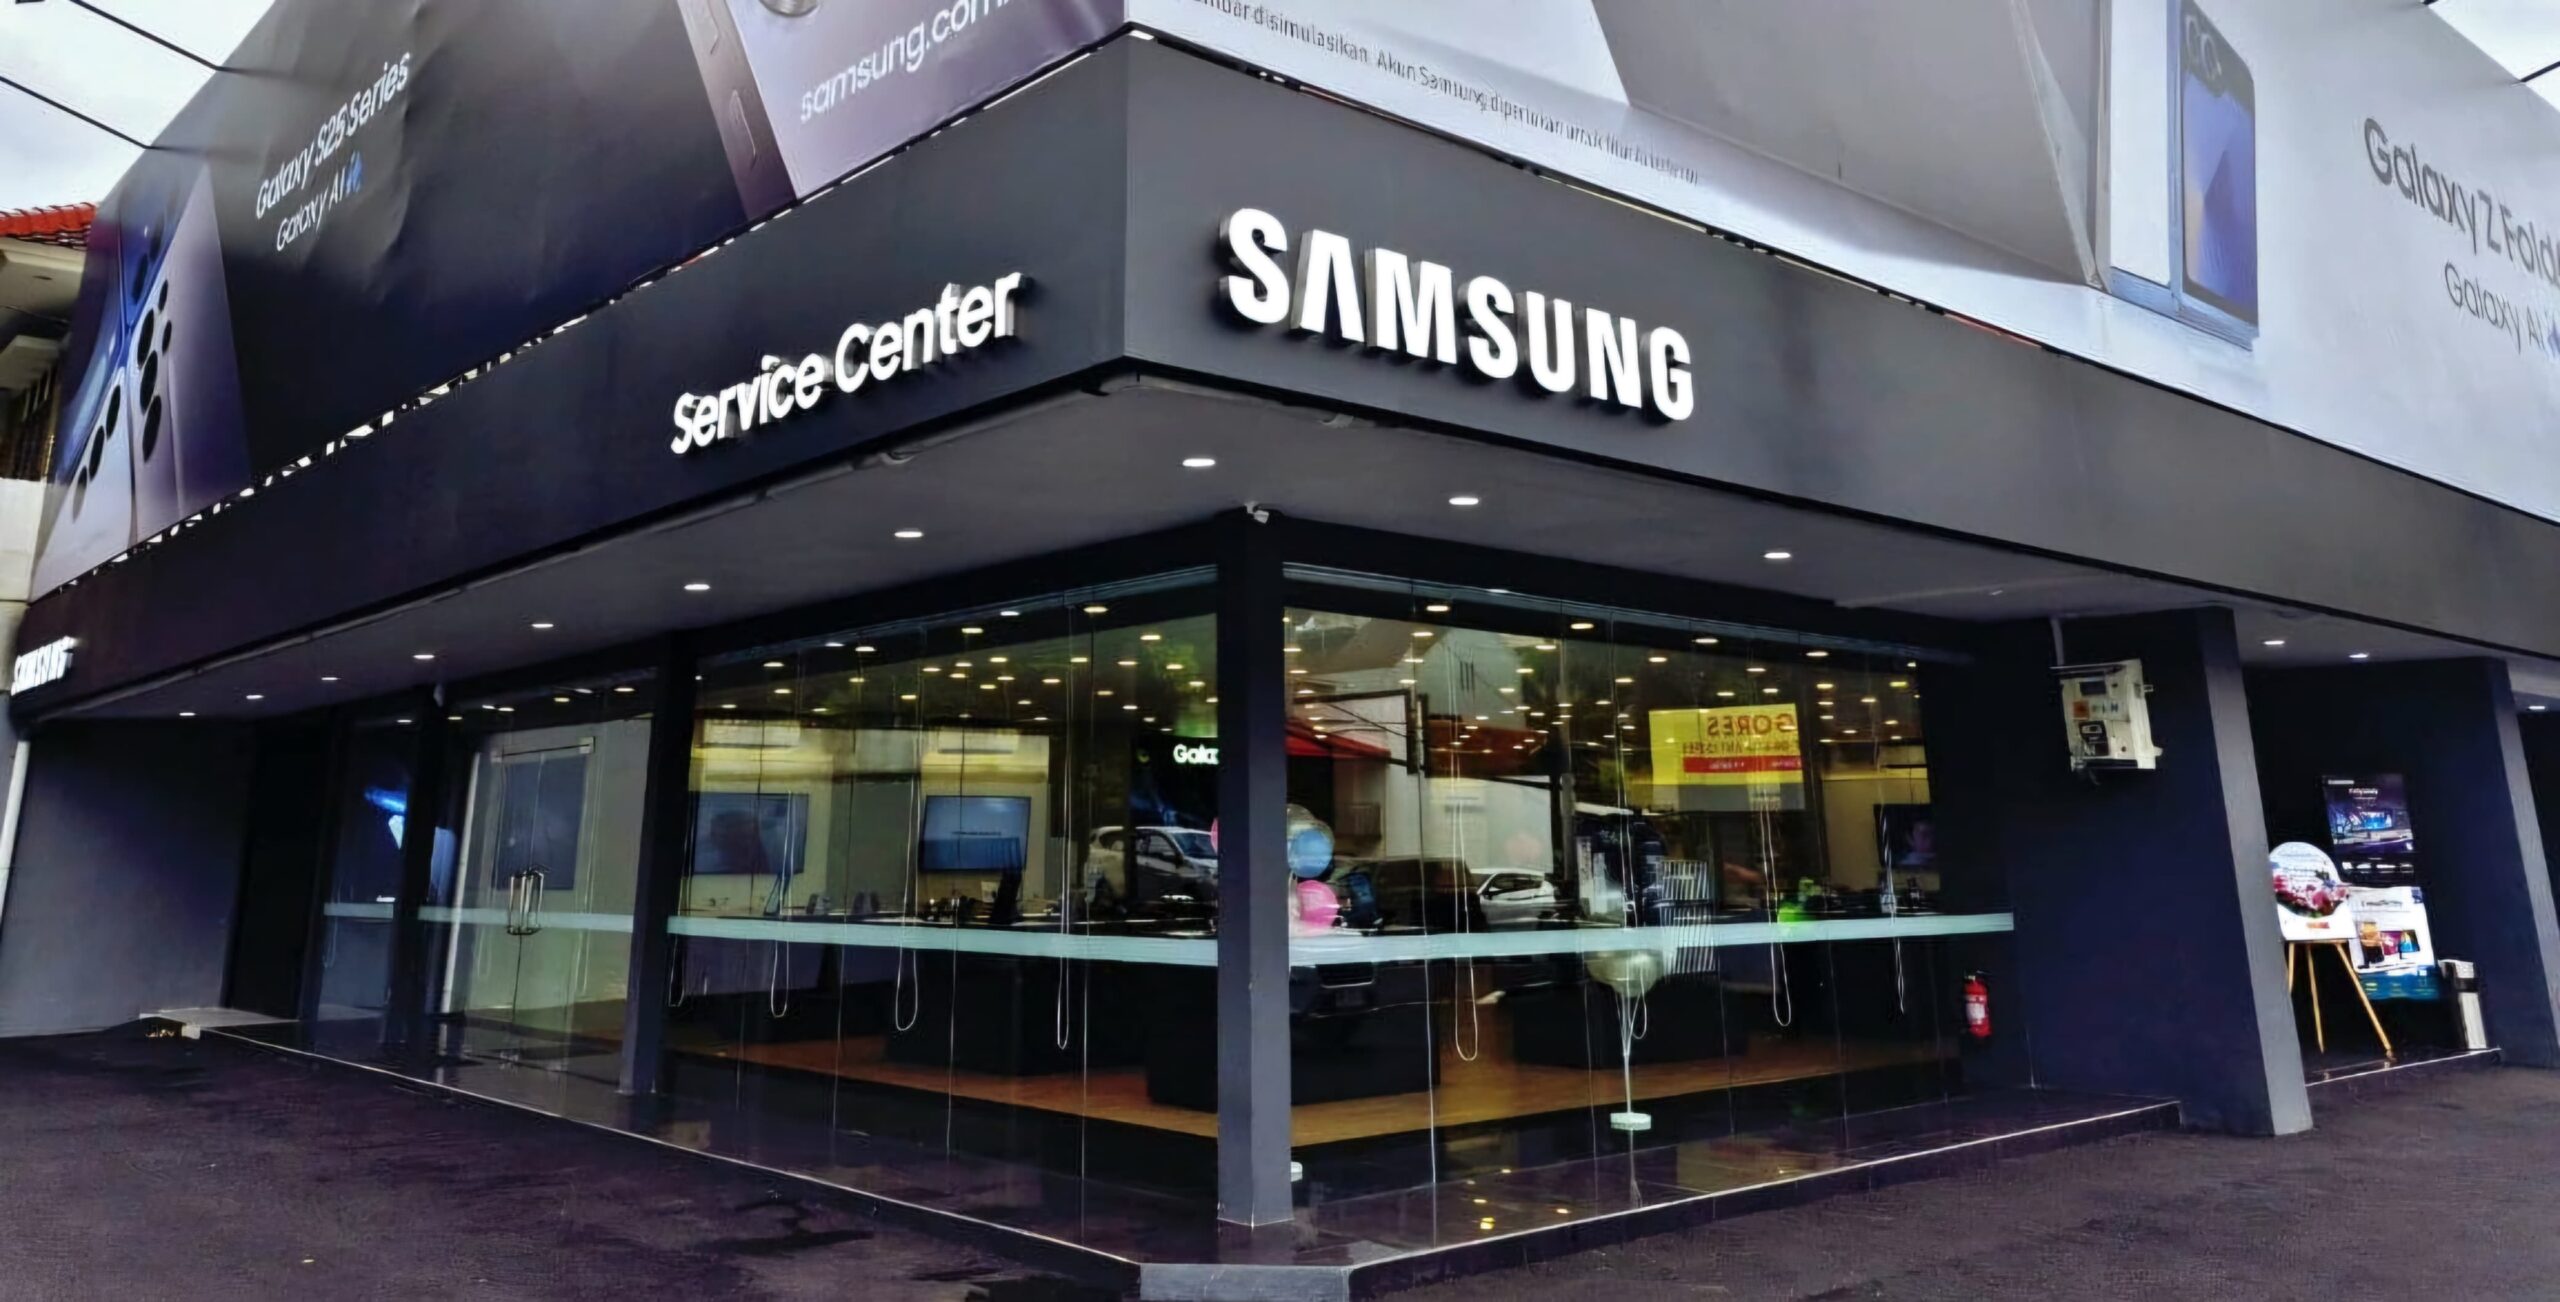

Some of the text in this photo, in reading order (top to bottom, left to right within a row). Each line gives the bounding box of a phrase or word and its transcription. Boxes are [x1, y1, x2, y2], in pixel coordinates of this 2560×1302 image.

[256, 51, 411, 219] Galaxy S25 Series
[276, 167, 346, 251] Galaxy AI
[2364, 117, 2560, 291] Galaxy Z Fold
[670, 271, 1024, 454] Service Center
[1222, 207, 1695, 421] SAMSUNG
[2444, 261, 2521, 355] Galaxy
